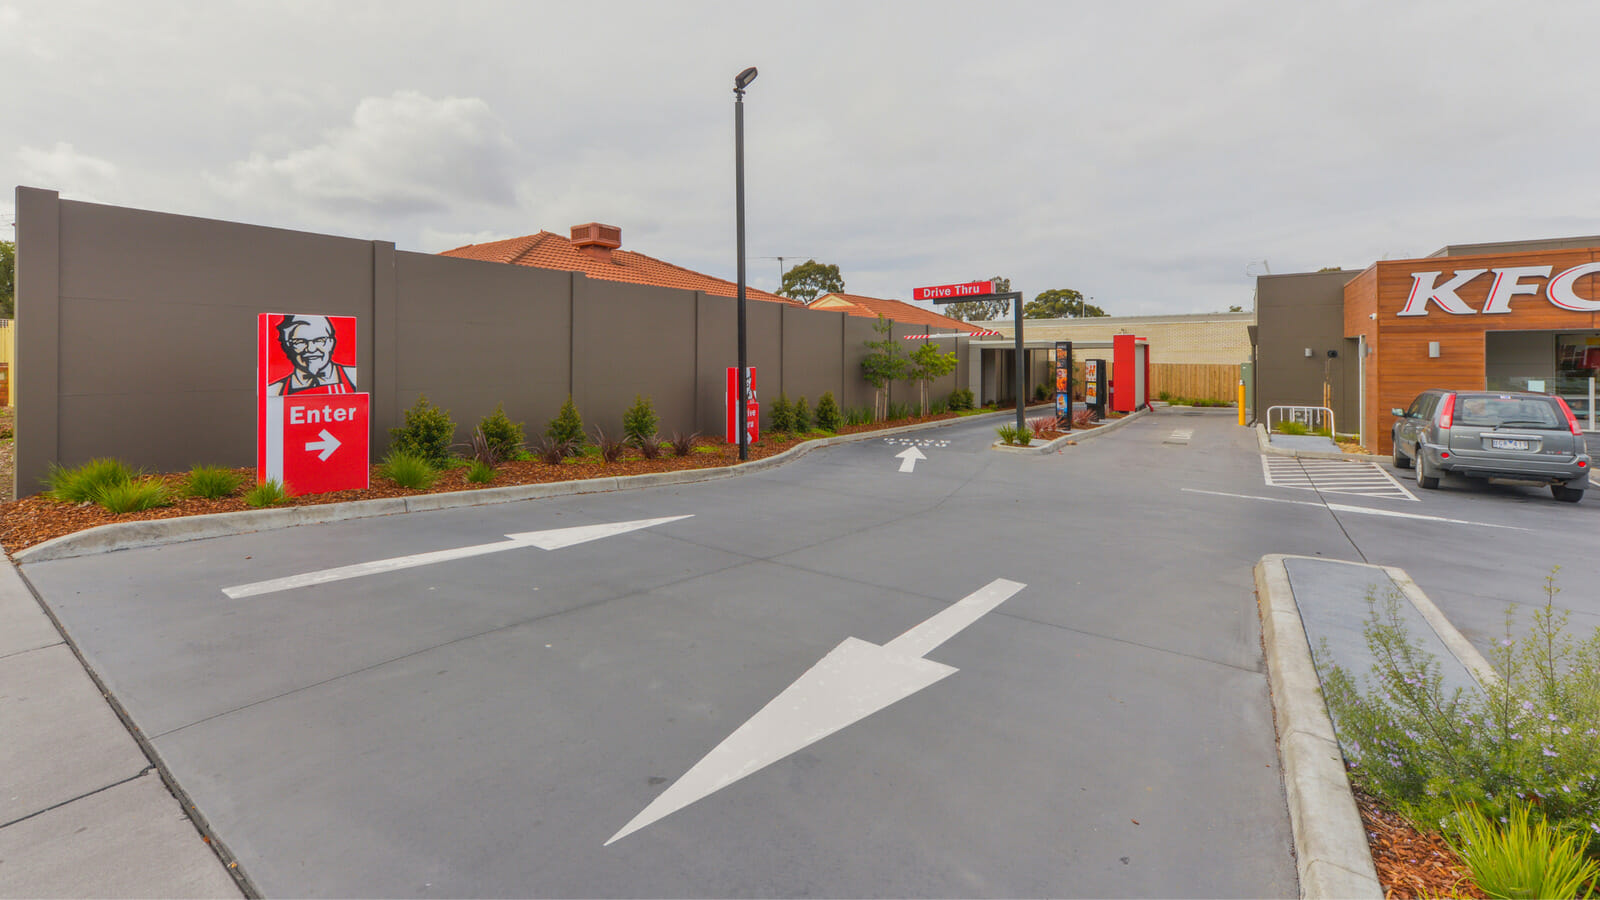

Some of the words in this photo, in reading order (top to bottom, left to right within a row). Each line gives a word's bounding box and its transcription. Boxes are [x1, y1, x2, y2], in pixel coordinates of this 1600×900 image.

[923, 287, 951, 298] Drive
[954, 285, 980, 295] Thru
[290, 405, 357, 425] Enter
